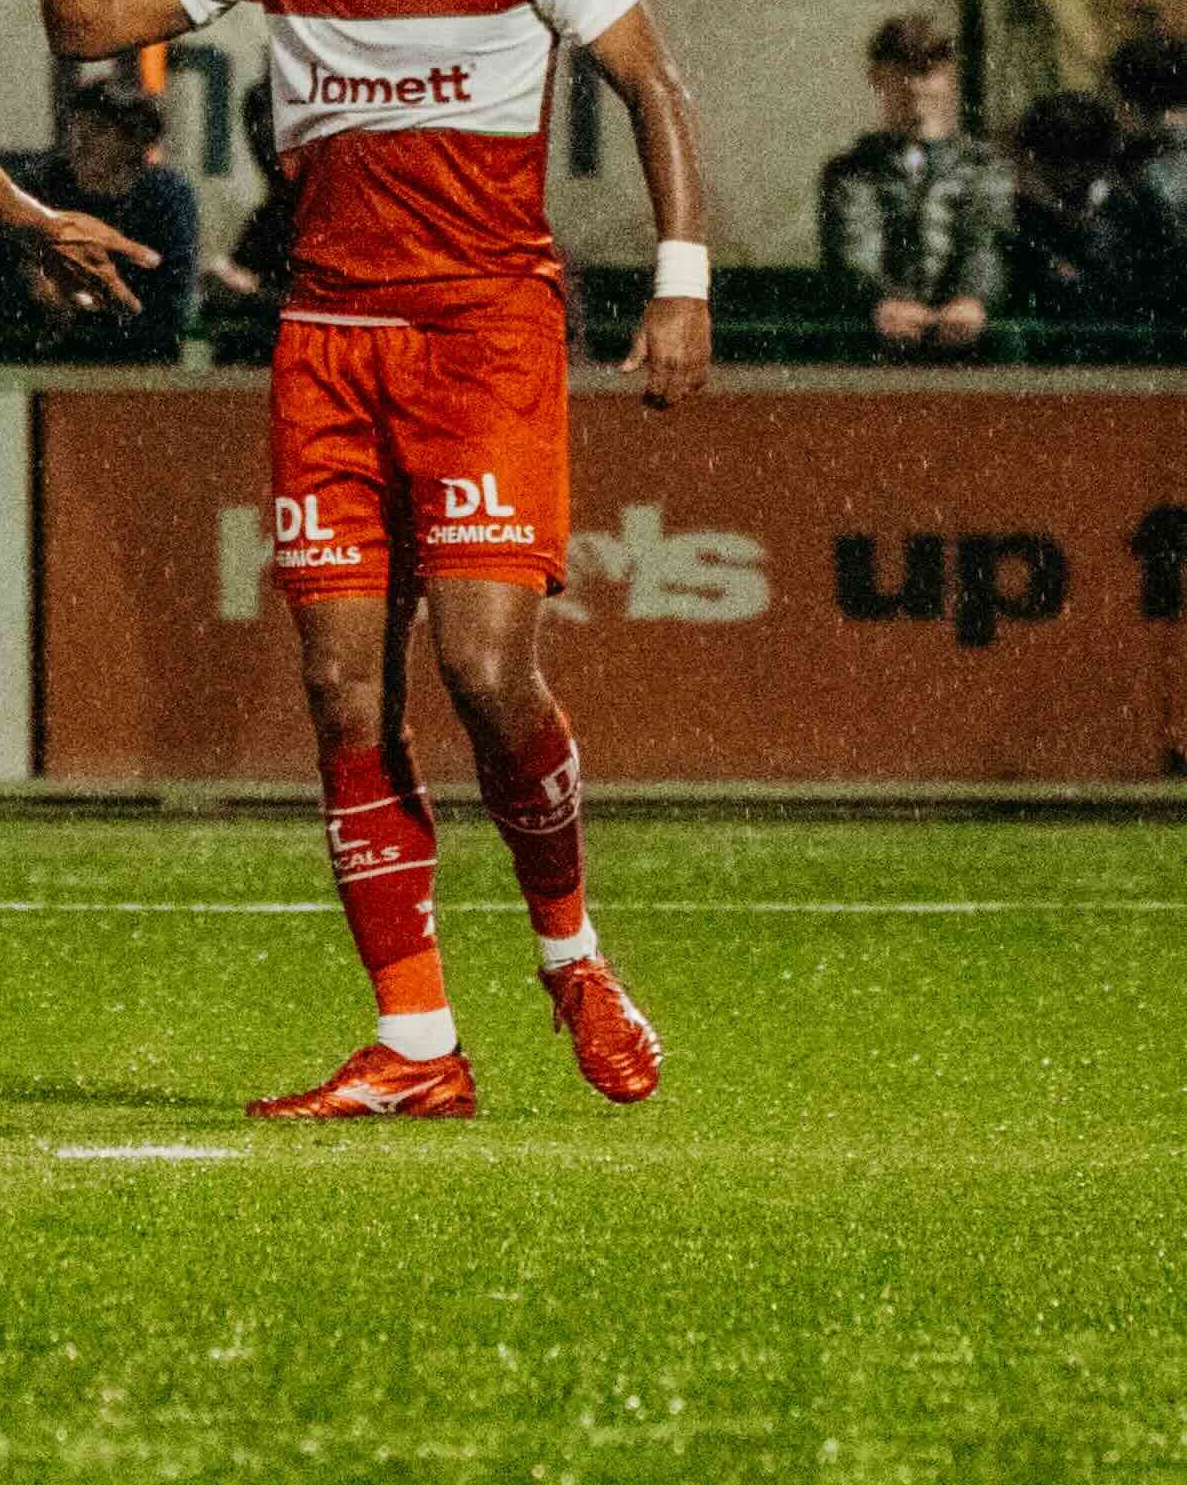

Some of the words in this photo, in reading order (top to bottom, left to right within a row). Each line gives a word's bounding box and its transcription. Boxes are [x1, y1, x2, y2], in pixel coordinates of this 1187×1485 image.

[275, 494, 335, 542] DL
[439, 472, 516, 518] DL
[426, 523, 536, 545] CHEMICALS
[834, 530, 1071, 650] up
